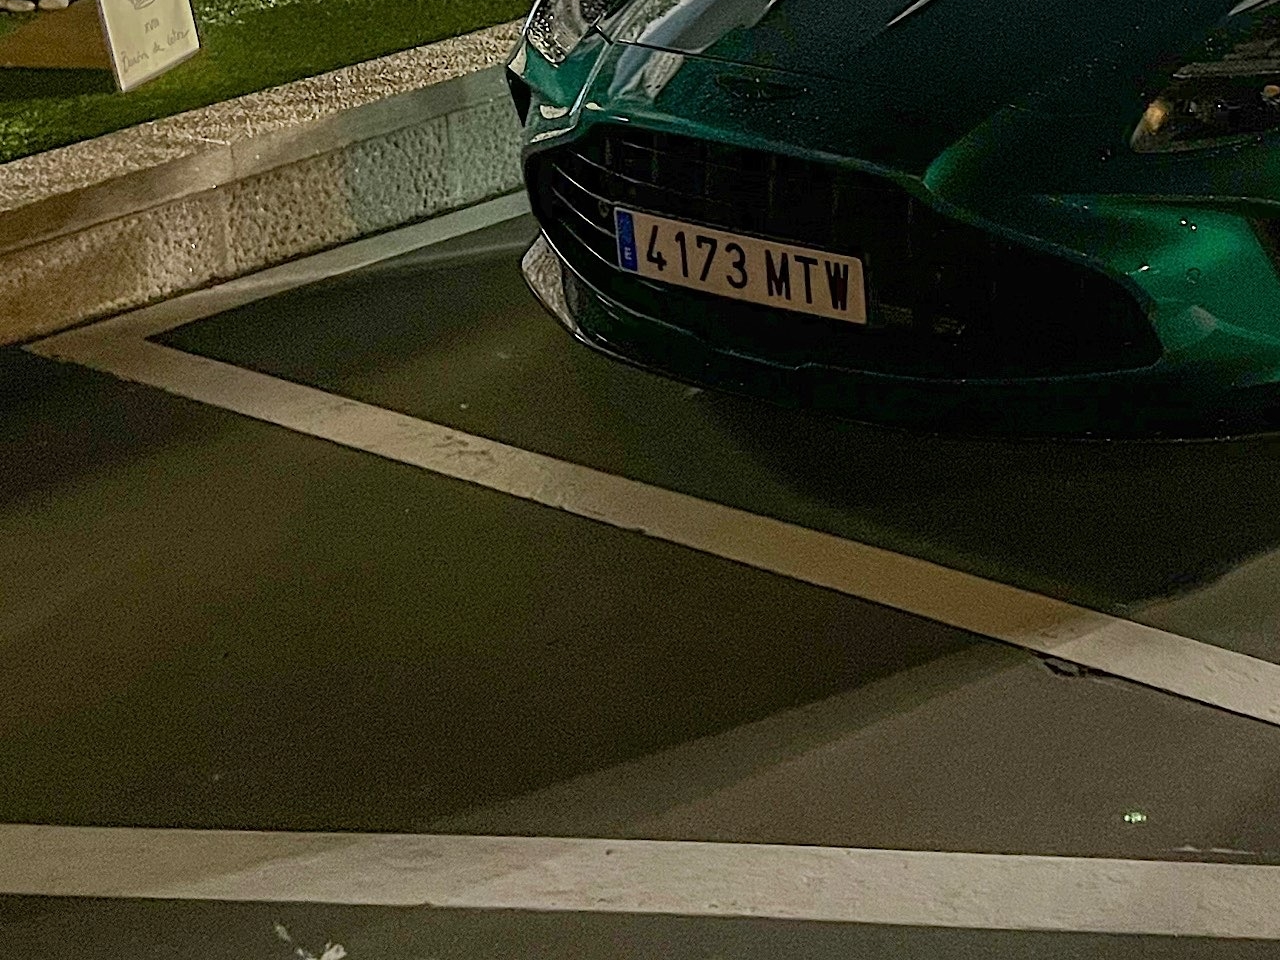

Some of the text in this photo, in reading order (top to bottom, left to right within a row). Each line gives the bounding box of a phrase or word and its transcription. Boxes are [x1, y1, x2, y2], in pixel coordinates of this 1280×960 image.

[624, 246, 632, 260] E
[646, 225, 849, 311] 4173 MTW
